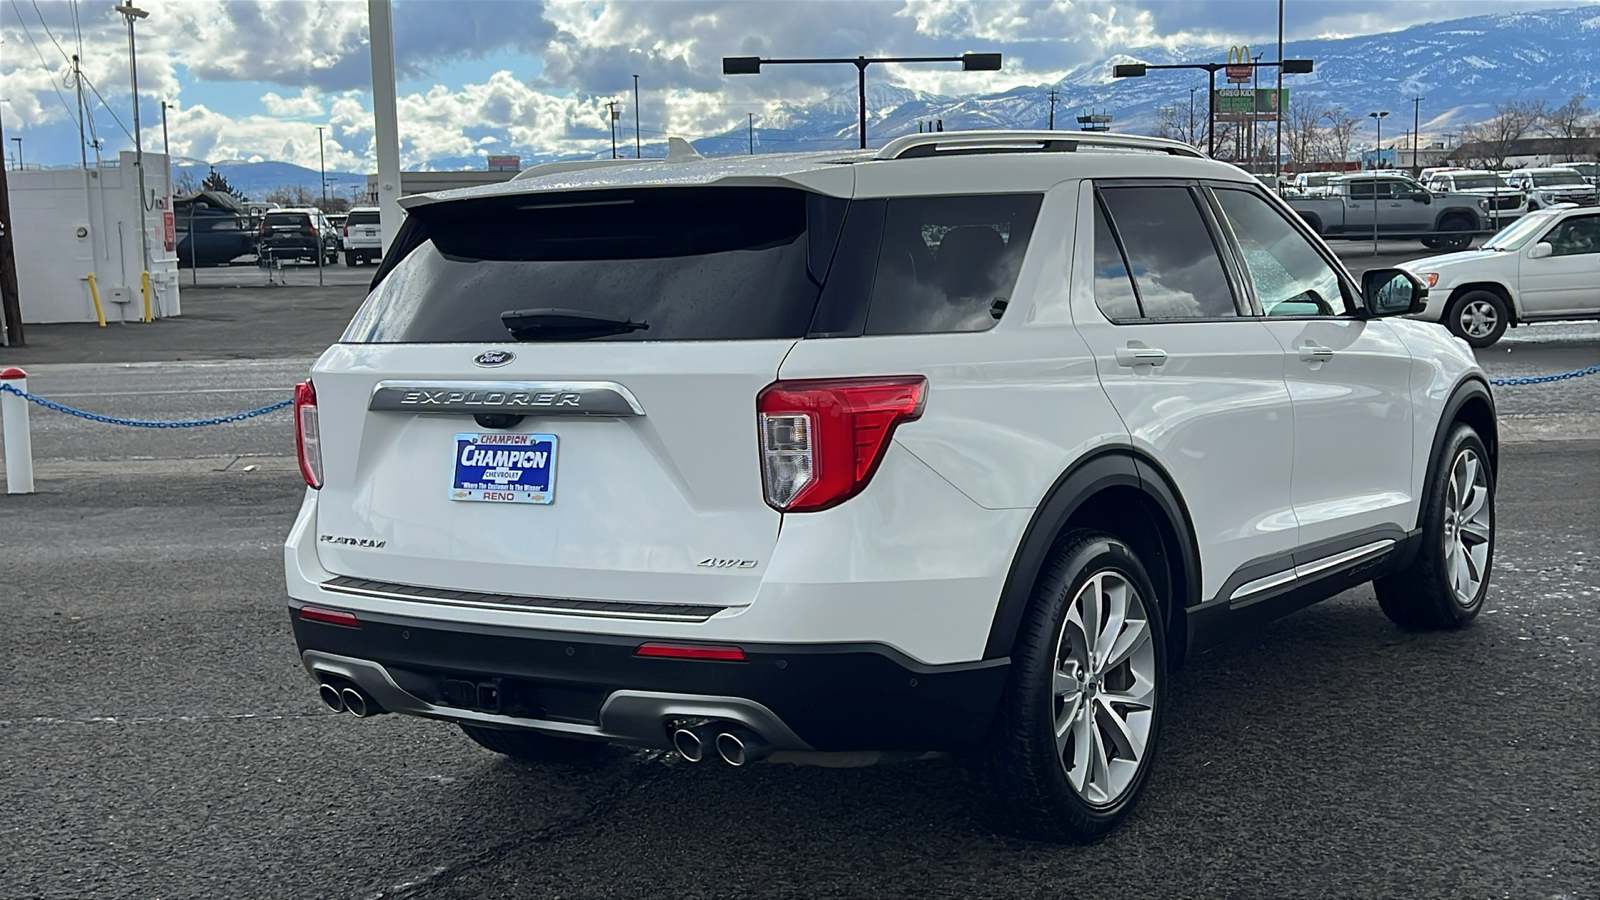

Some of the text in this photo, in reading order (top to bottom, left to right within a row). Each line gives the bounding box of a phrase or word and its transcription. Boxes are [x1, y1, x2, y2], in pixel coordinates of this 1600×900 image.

[400, 391, 581, 407] EXPLORER
[480, 435, 528, 444] CHAMPION
[461, 445, 548, 468] CHAMPION
[483, 492, 515, 501] RENO
[320, 535, 387, 548] PLATINUM
[696, 557, 759, 569] 4WD
